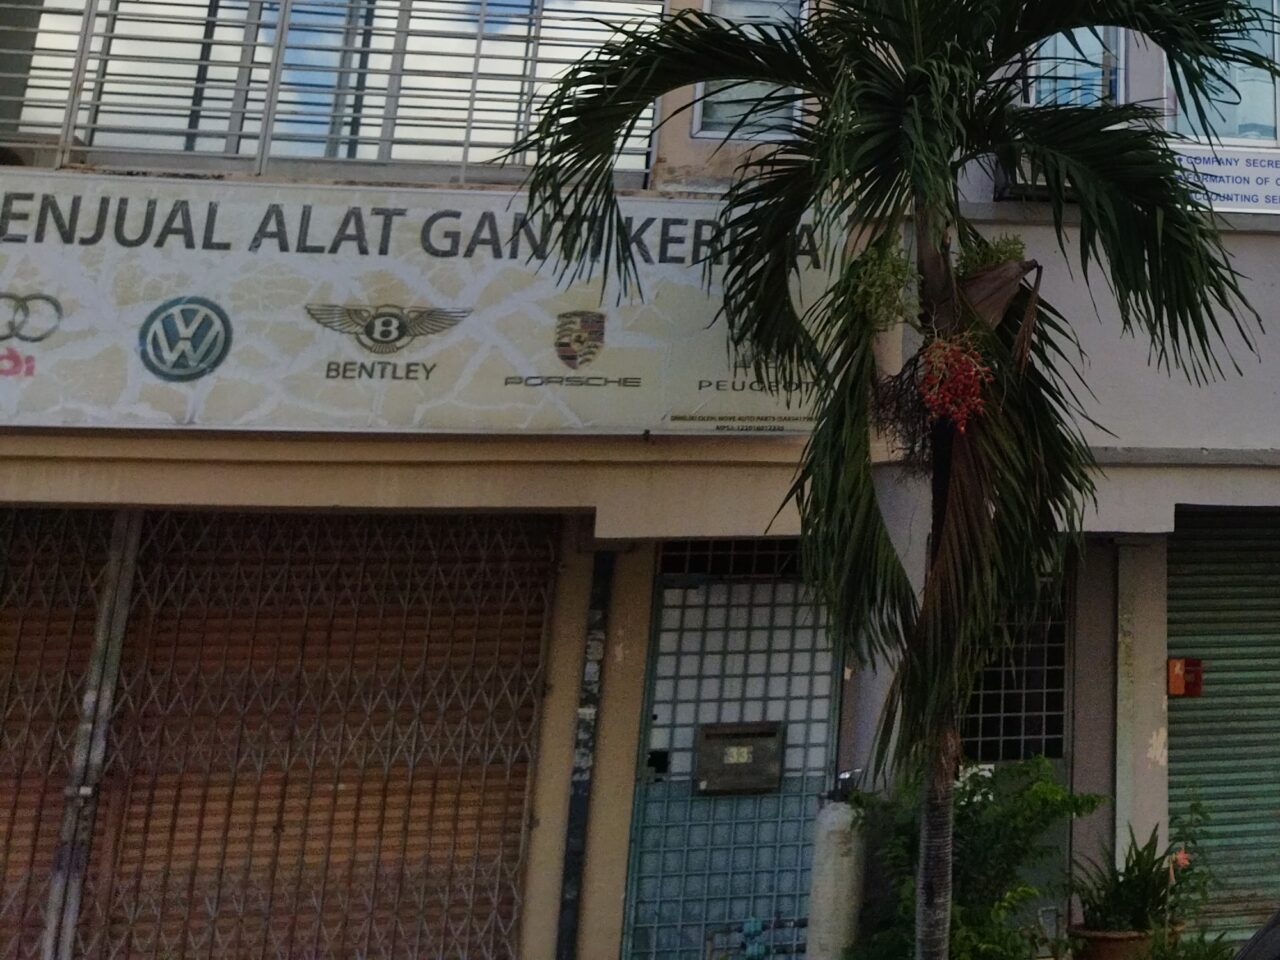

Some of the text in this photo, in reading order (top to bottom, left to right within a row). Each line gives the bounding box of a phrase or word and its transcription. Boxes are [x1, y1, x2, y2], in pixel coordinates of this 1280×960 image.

[1186, 156, 1239, 167] COMPANY
[1255, 177, 1271, 186] OF
[247, 203, 408, 256] ALAT
[325, 361, 437, 381] BENTLEY
[504, 375, 642, 387] PORSCHE
